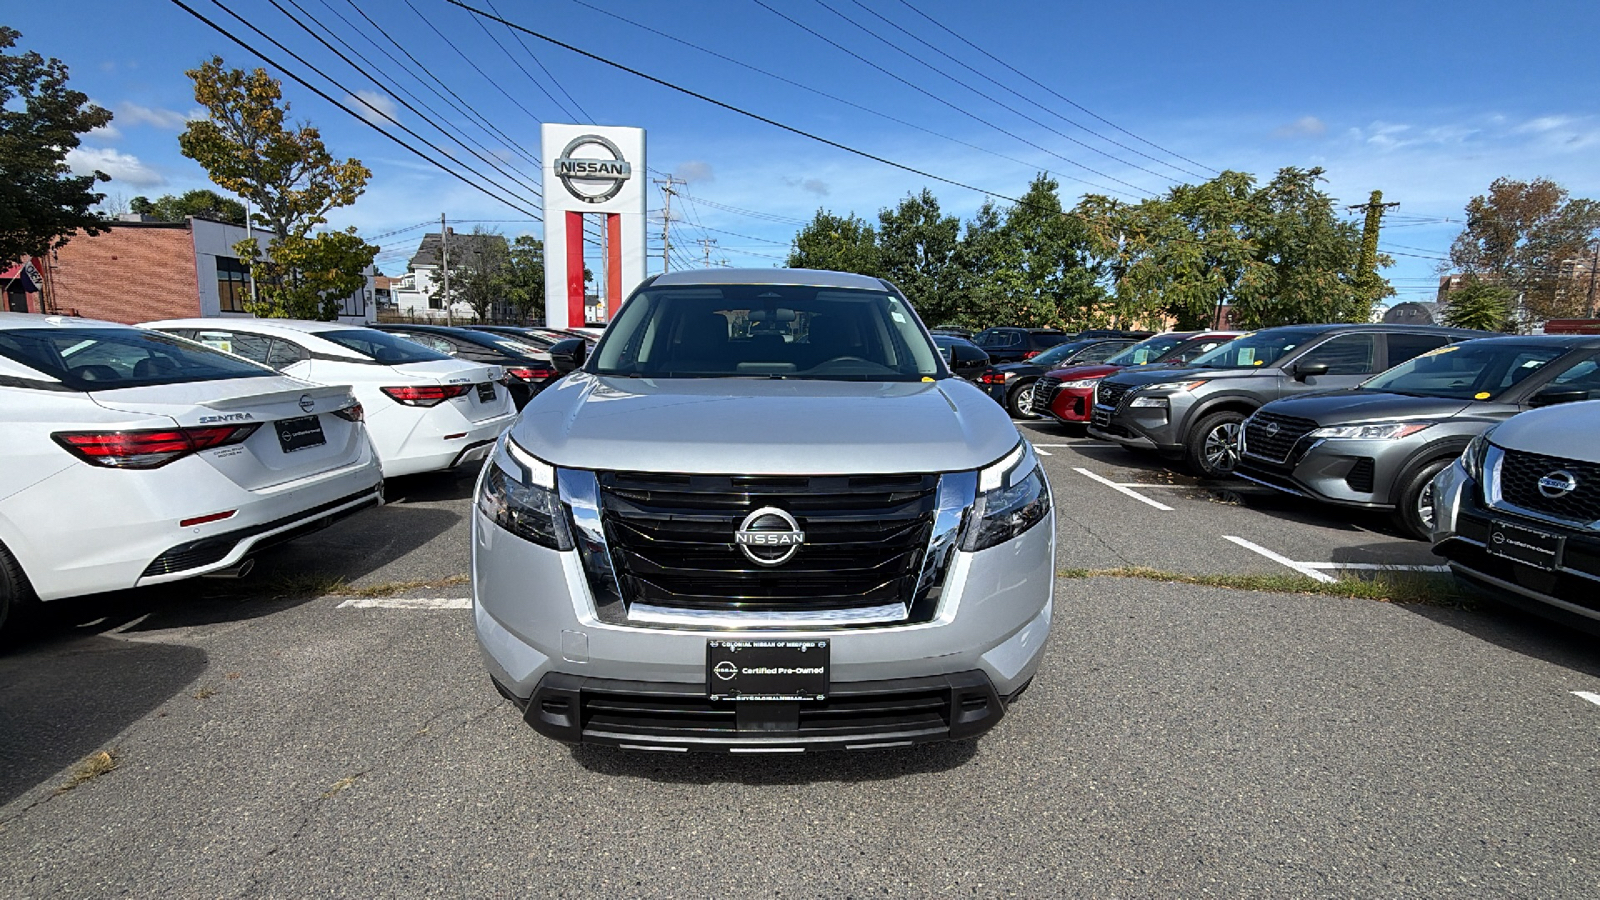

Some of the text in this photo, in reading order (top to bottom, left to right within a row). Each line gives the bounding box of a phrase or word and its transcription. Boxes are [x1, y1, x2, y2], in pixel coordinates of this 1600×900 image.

[561, 161, 623, 175] NISSAN
[199, 412, 254, 424] SENTRA
[736, 533, 803, 544] NISSAN
